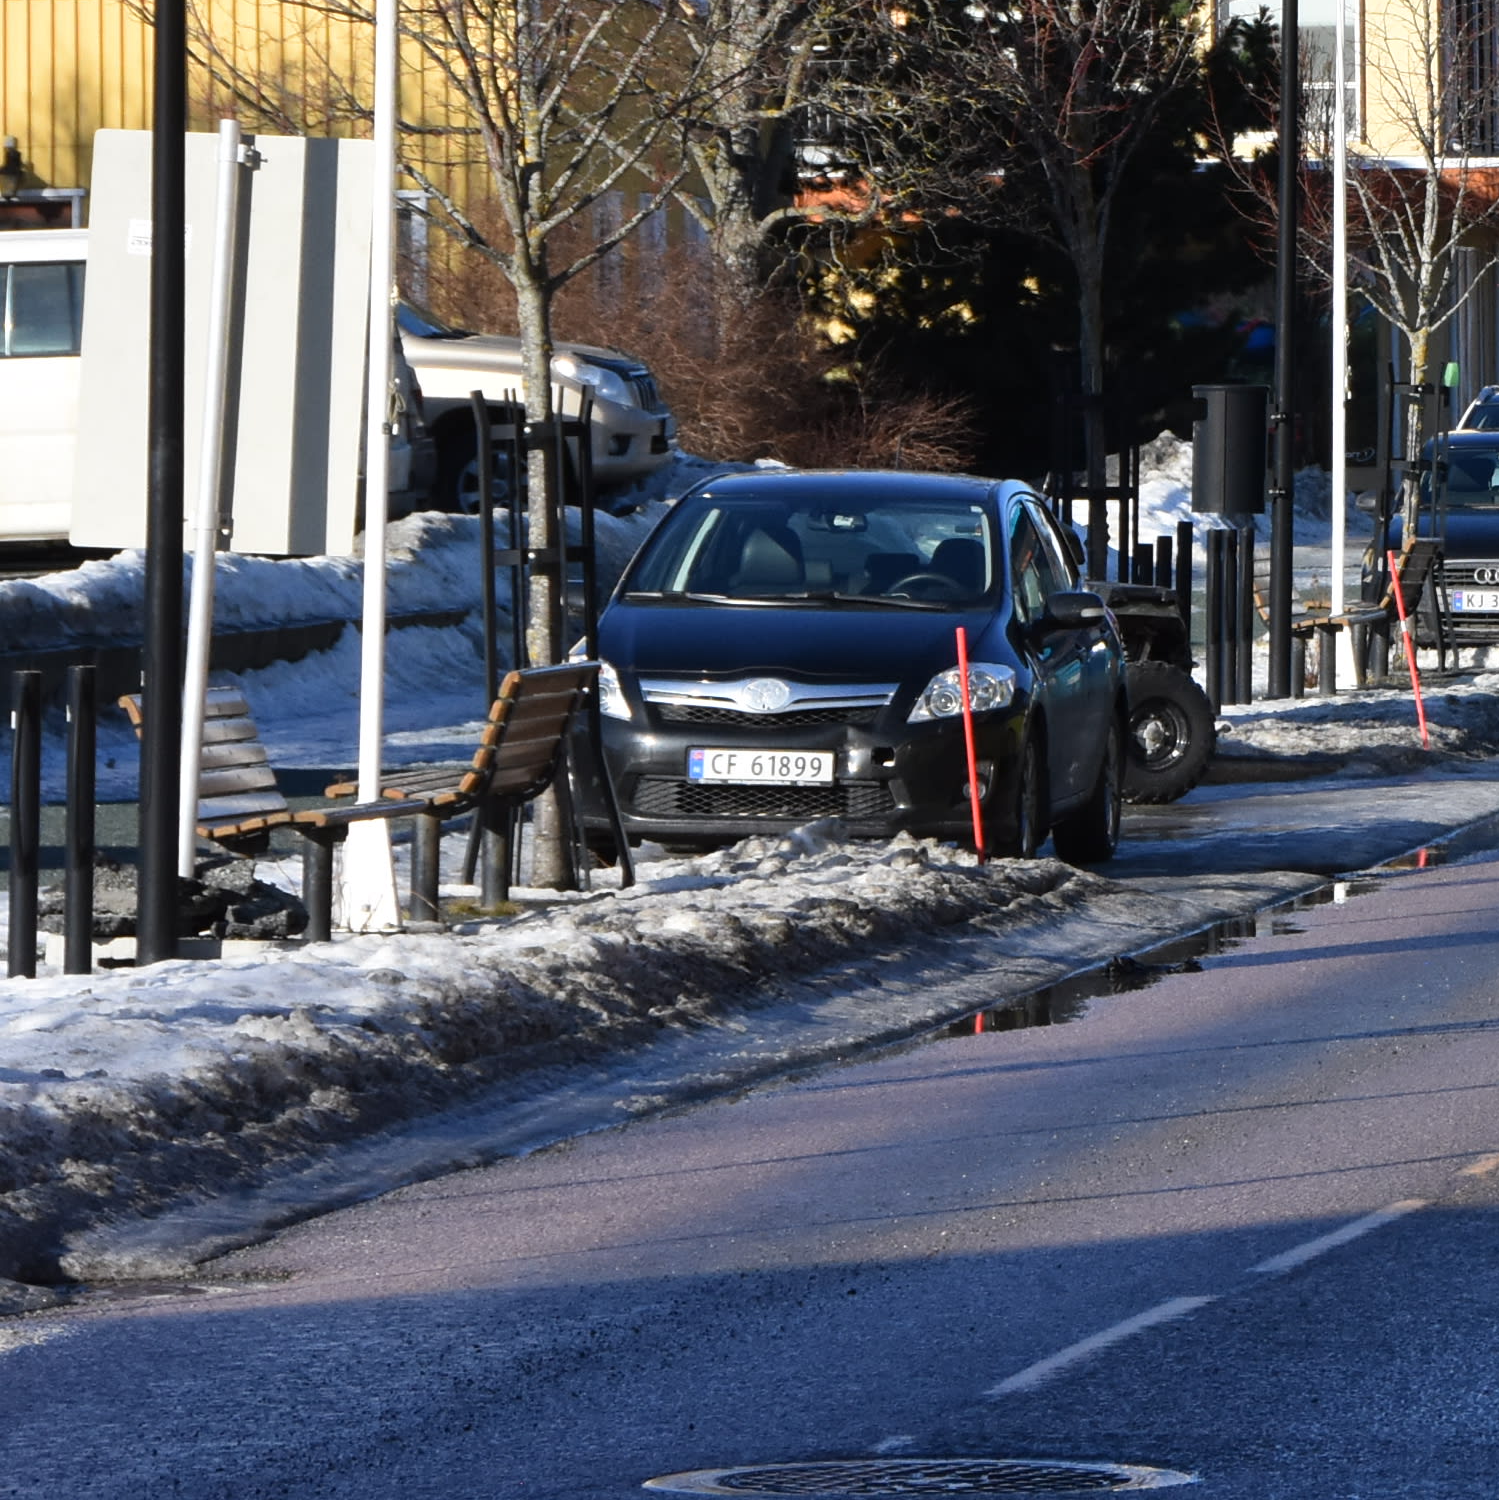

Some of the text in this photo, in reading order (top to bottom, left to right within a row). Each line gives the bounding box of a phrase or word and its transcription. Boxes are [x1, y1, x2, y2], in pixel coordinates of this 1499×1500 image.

[1466, 594, 1484, 608] KJ
[711, 753, 822, 778] CF 61899
